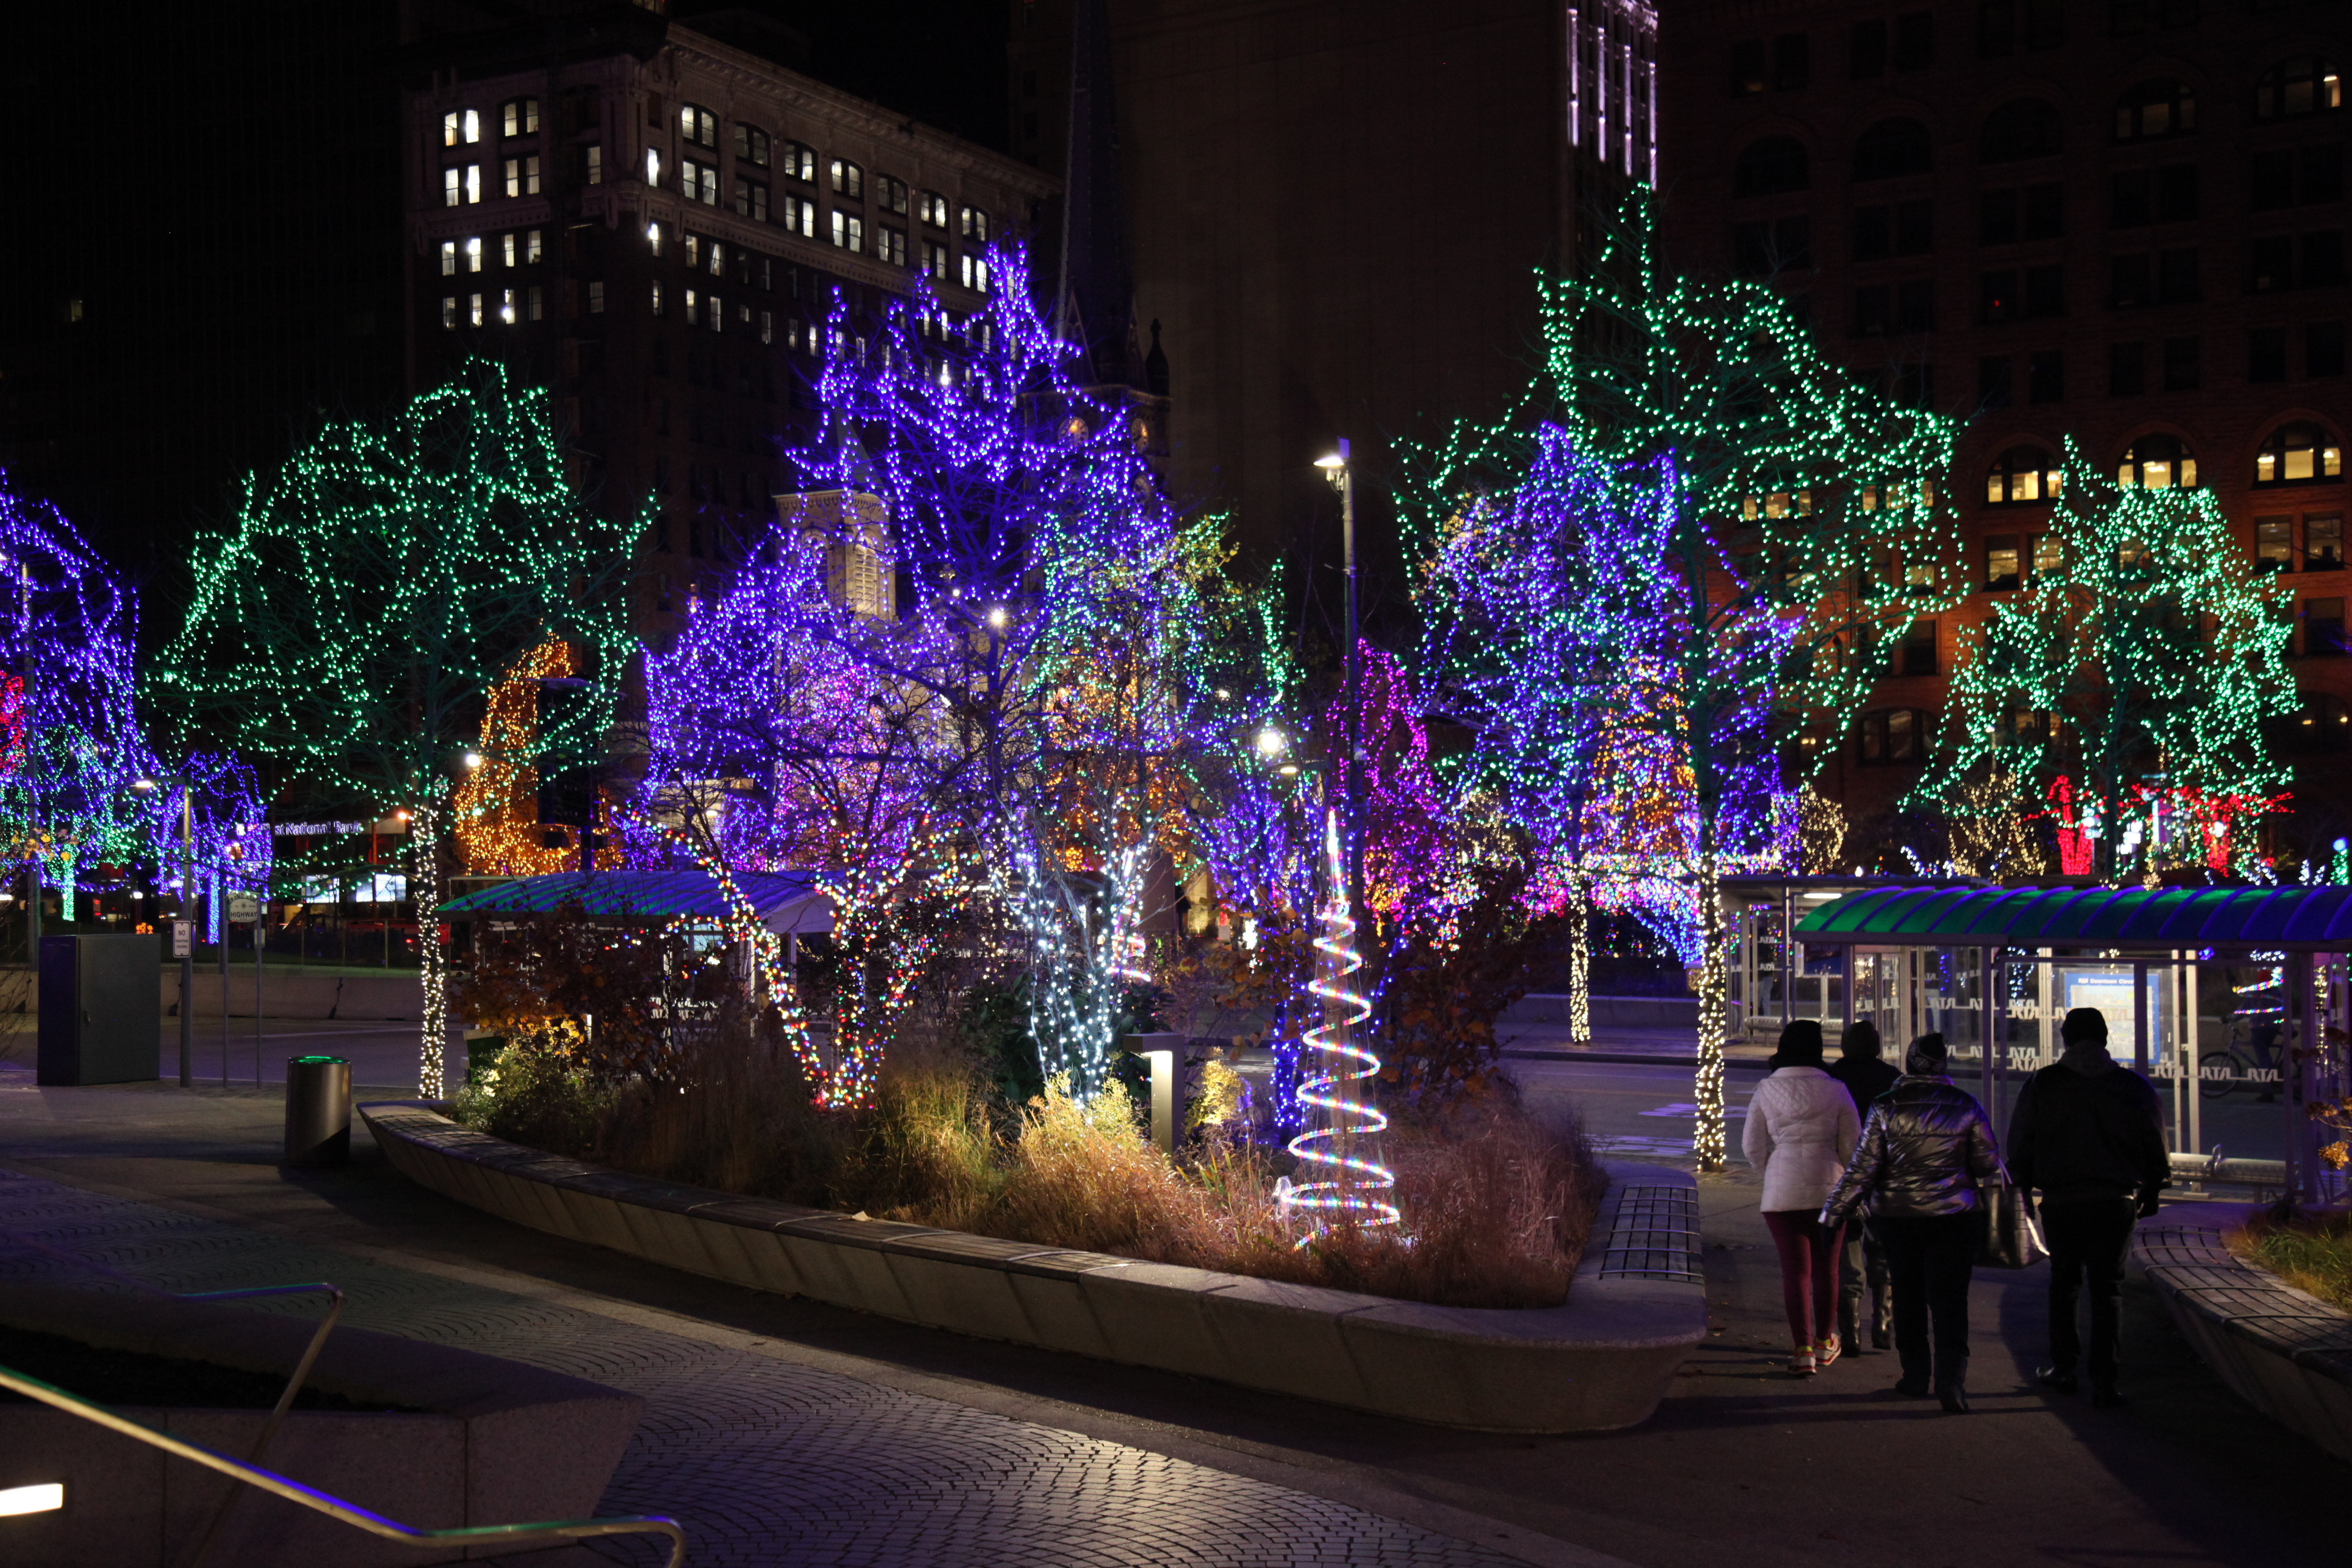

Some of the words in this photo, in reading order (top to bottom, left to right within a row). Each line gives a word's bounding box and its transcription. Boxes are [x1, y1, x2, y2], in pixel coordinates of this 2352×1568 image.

[286, 821, 331, 836] National
[334, 820, 363, 834] Bank
[2012, 1006, 2040, 1020] RTA
[2012, 1058, 2040, 1072] RTA
[2155, 1065, 2184, 1079] RTA
[2201, 1066, 2231, 1081] RTA
[2248, 1068, 2278, 1083] RTA
